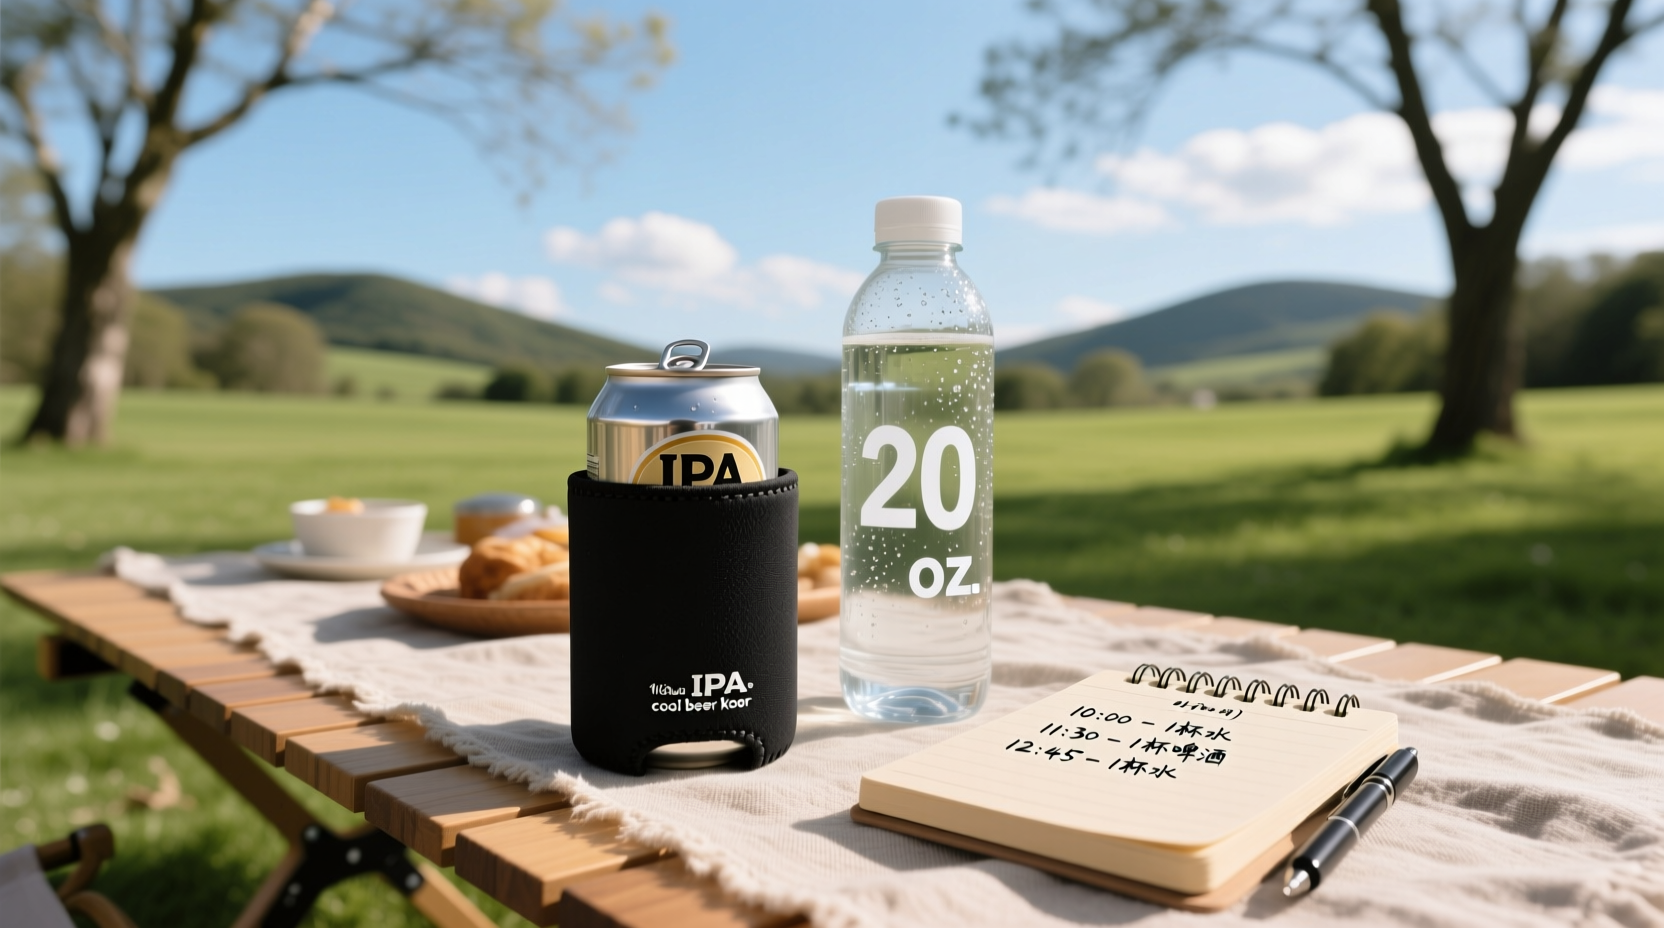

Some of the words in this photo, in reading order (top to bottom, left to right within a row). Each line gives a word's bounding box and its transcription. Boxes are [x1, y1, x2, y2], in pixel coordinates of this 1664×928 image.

[660, 453, 742, 486] IPA
[860, 425, 977, 531] 20
[651, 699, 682, 712] cool
[685, 698, 718, 712] beer
[720, 697, 753, 711] koor
[1070, 706, 1132, 724] 10:00
[1165, 721, 1231, 742] 1杯水
[1005, 739, 1084, 762] 12:45
[1108, 757, 1177, 779] 1杯水
[1040, 723, 1099, 741] 11:30
[1129, 737, 1227, 766] 1杯啤酒
